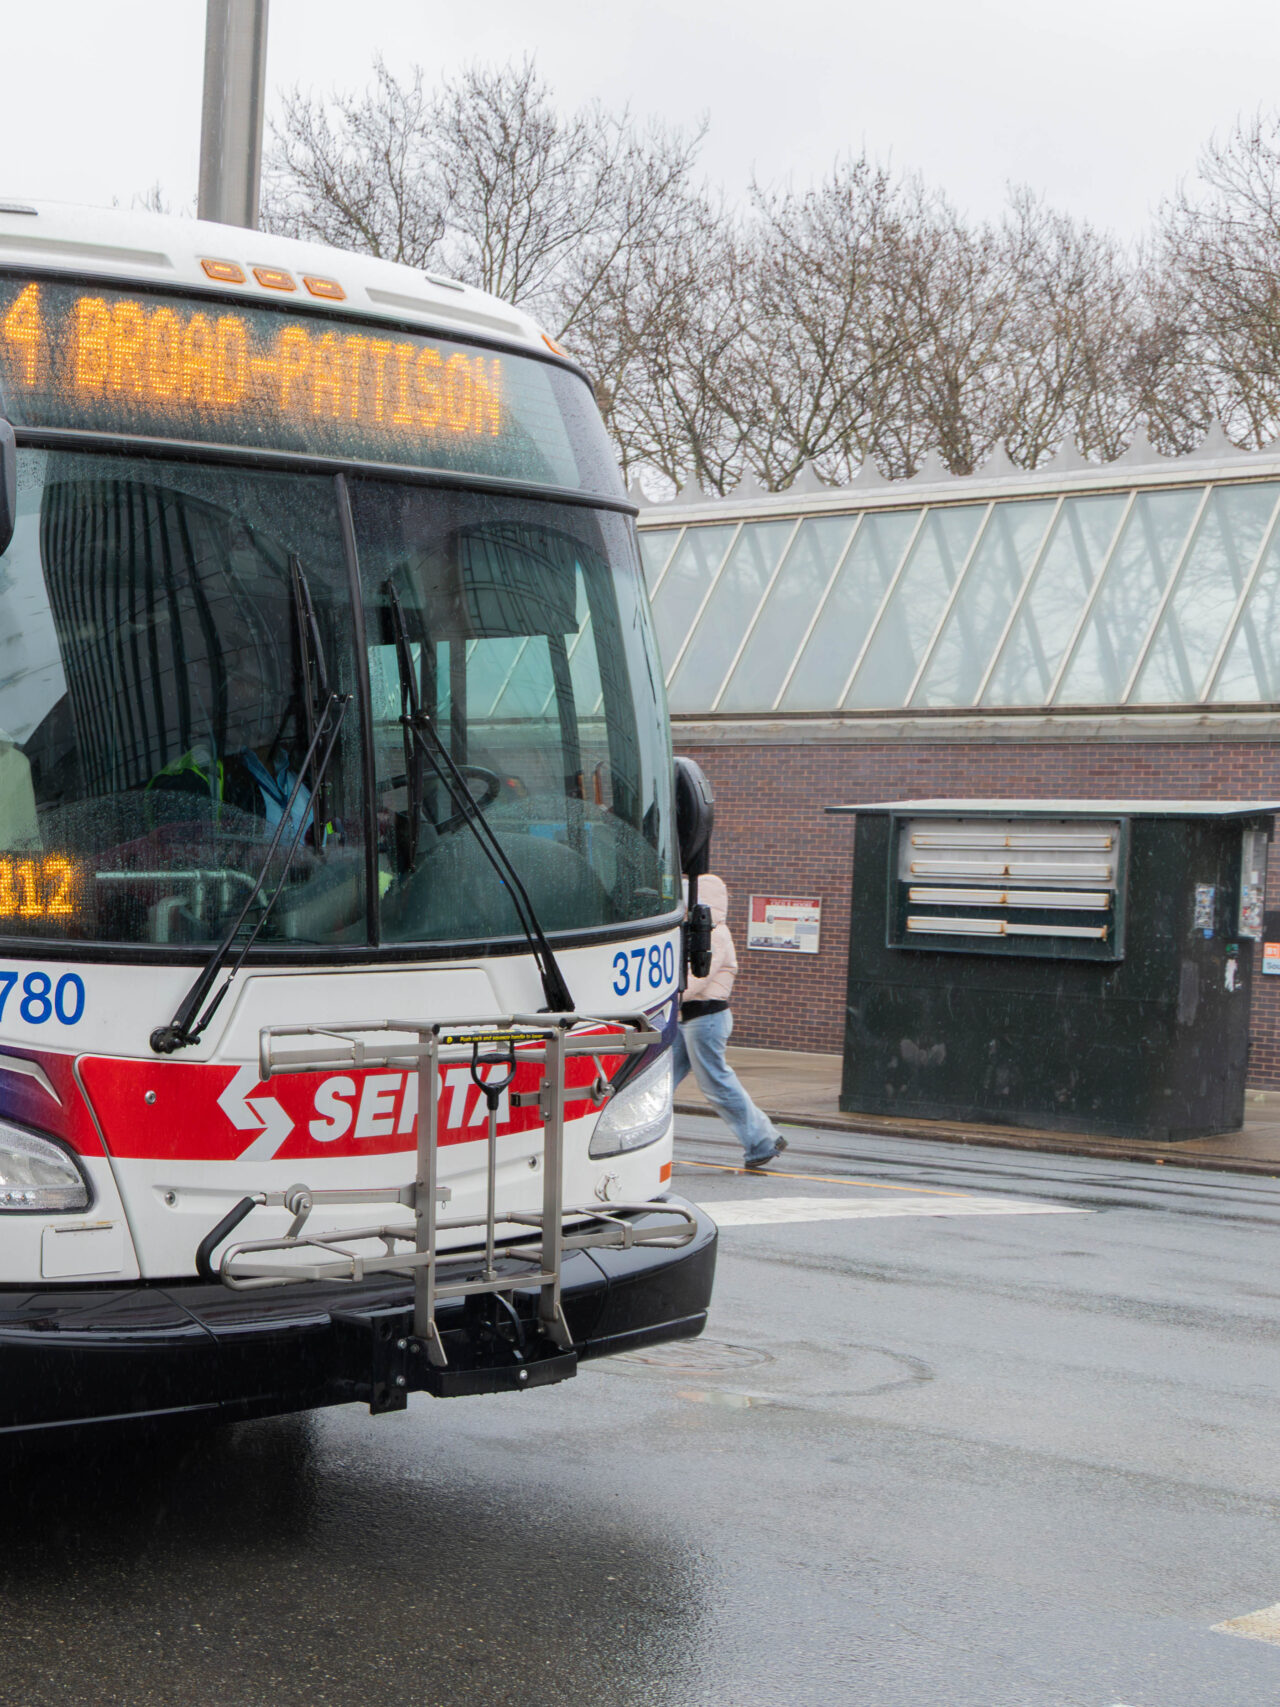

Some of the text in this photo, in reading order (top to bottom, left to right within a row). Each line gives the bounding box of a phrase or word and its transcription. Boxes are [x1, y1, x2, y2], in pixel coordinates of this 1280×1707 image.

[4, 282, 503, 438] 4 BROAD-PATTISON
[613, 941, 674, 996] 3780
[308, 1064, 511, 1143] SEPTA
